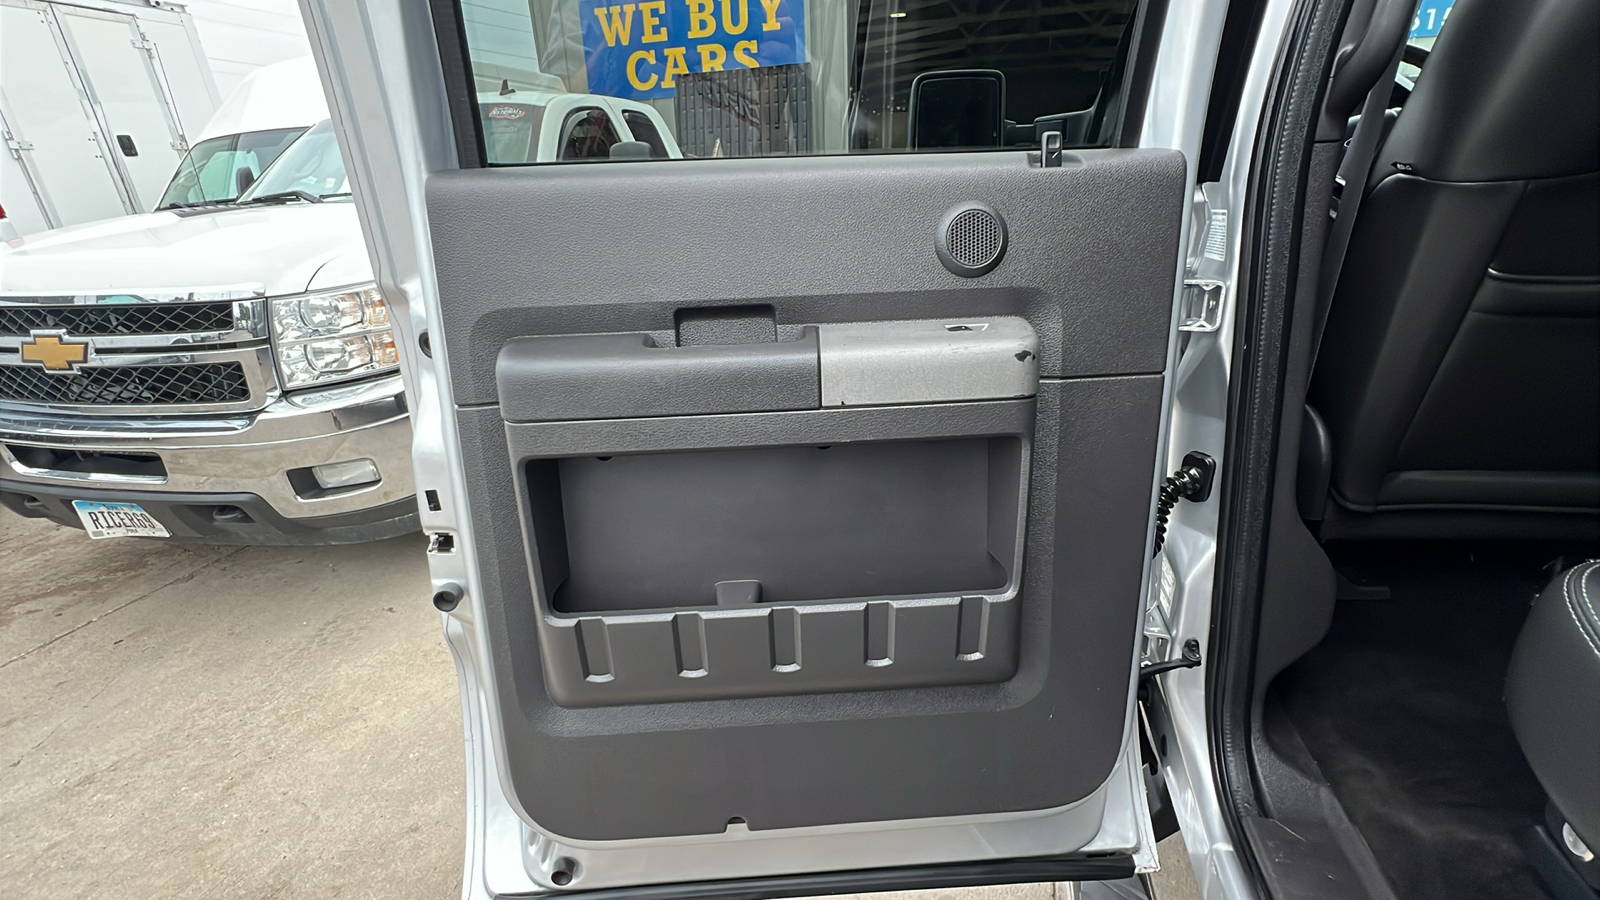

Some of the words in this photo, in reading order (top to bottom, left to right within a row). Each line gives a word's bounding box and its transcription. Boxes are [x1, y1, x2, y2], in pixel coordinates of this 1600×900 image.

[594, 1, 668, 47] WE
[686, 0, 781, 38] BUY
[626, 40, 760, 91] CARS
[88, 511, 155, 530] RICER69
